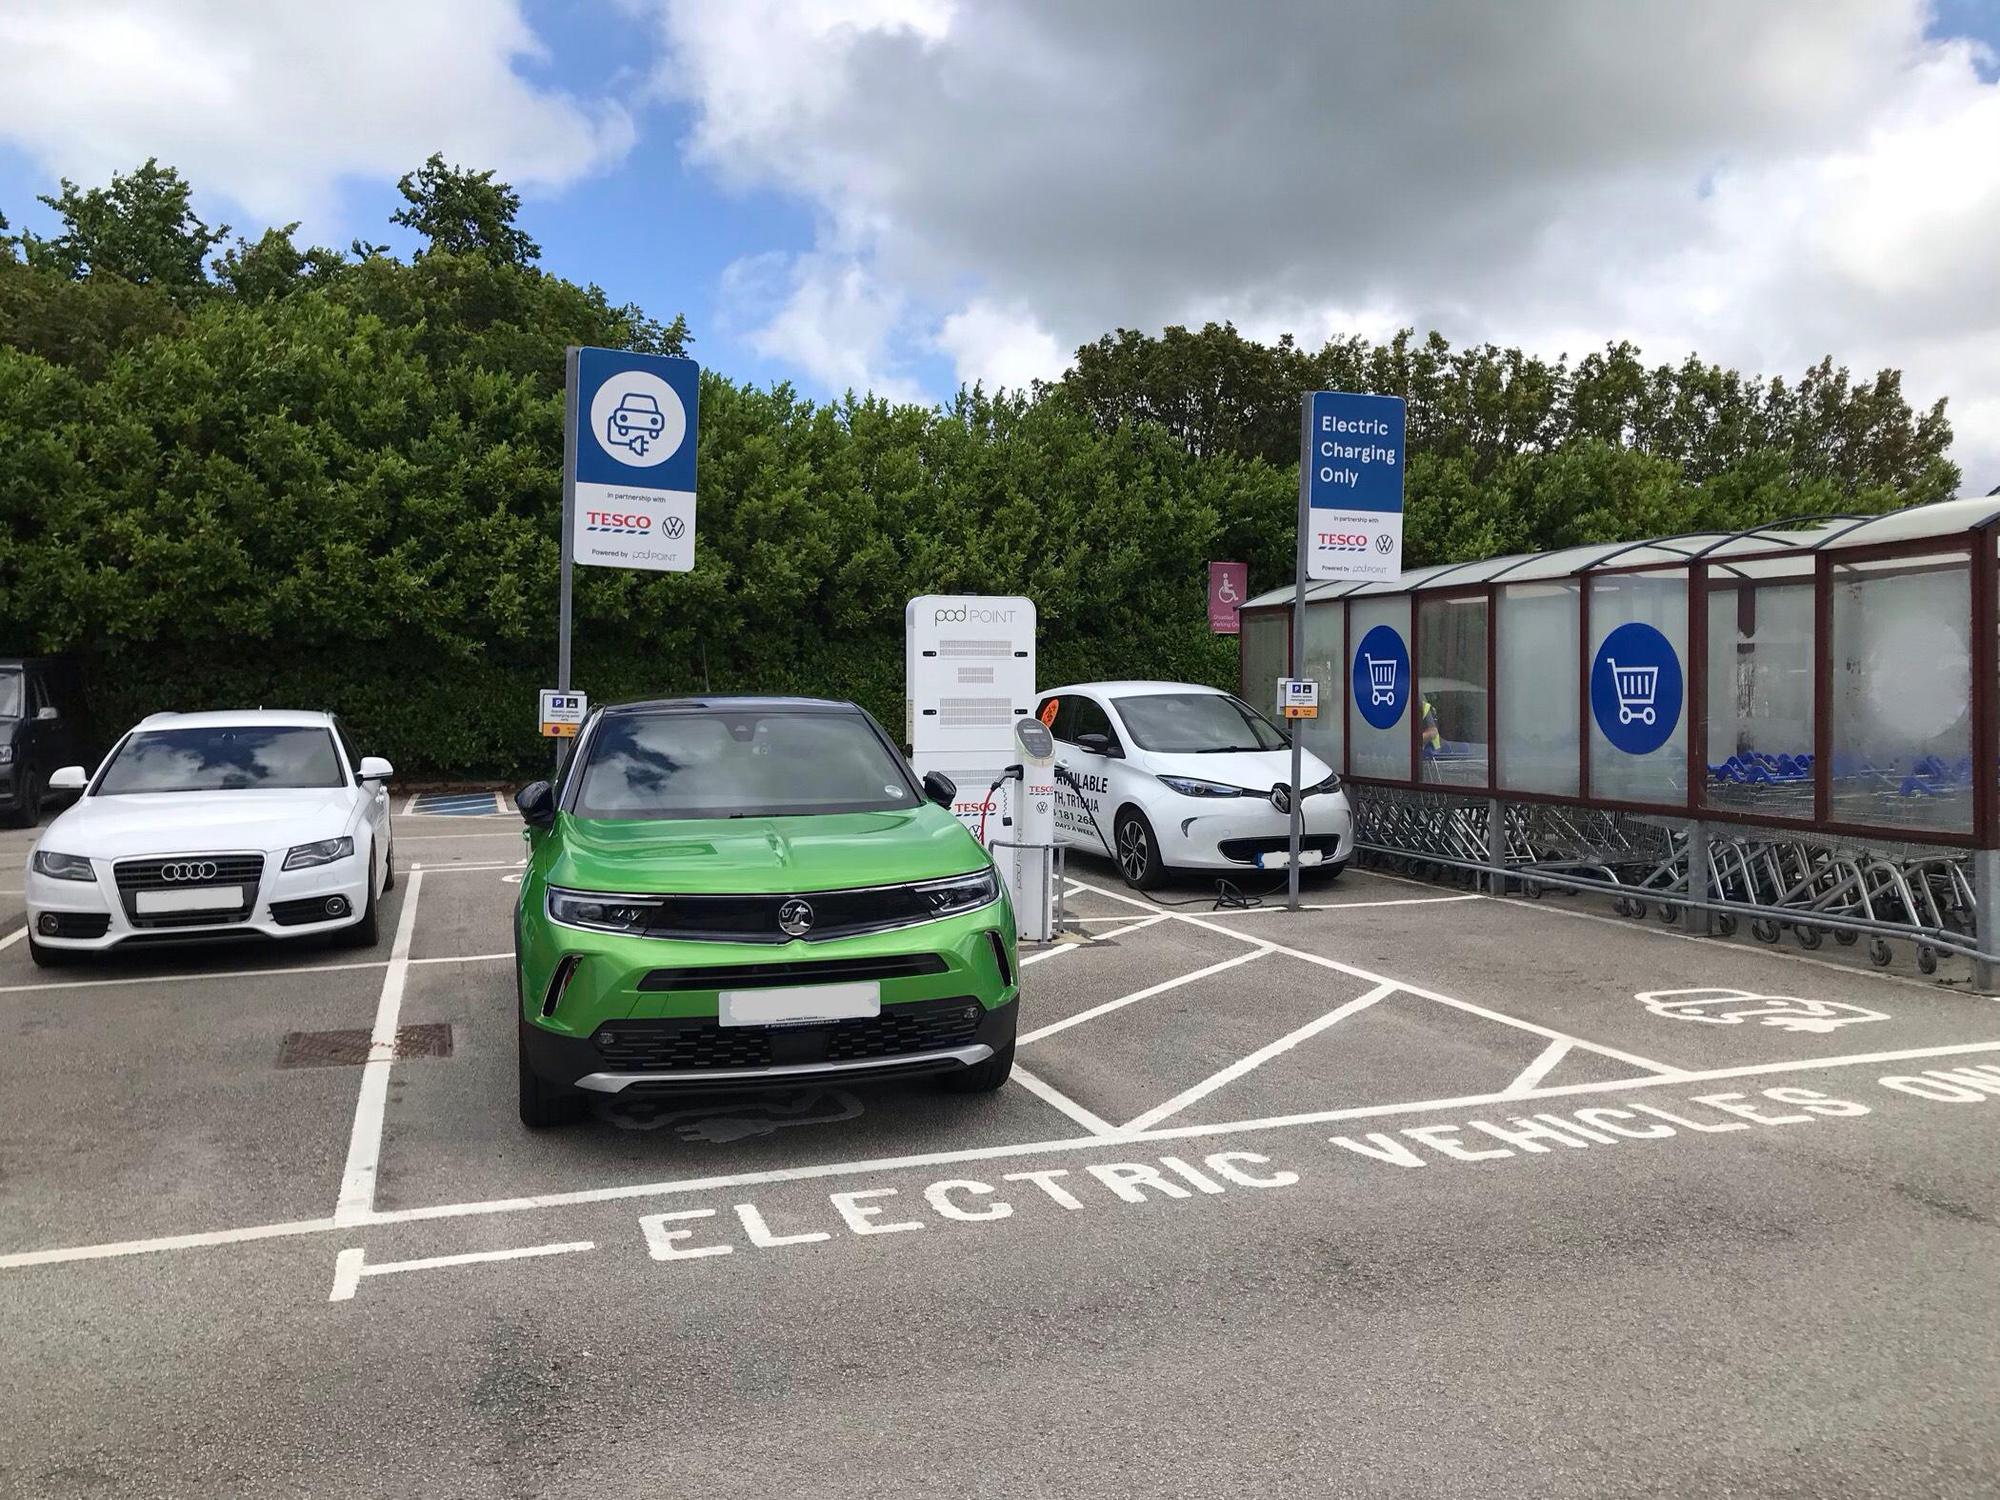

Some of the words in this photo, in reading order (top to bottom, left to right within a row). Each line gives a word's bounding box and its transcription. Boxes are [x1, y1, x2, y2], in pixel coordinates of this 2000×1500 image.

[1322, 416, 1389, 435] Electric
[1320, 442, 1395, 465] Charging
[1320, 467, 1359, 488] Only
[614, 493, 652, 503] partnership
[586, 511, 651, 529] TESCO
[1339, 516, 1367, 524] partnership
[1317, 533, 1367, 546] TESCO
[591, 548, 619, 557] Powered
[620, 550, 628, 558] by
[1321, 564, 1343, 572] Powered
[934, 603, 966, 627] pod
[969, 609, 1017, 624] POINT
[1056, 771, 1109, 793] AVAILABLE
[1028, 785, 1054, 793] TESCO
[954, 802, 997, 812] TESCO
[1055, 821, 1071, 830] DAYS
[638, 1151, 1300, 1262] ELECTRIC
[1328, 1087, 1872, 1168] VEHICLES
[1878, 1064, 2000, 1103] ON
